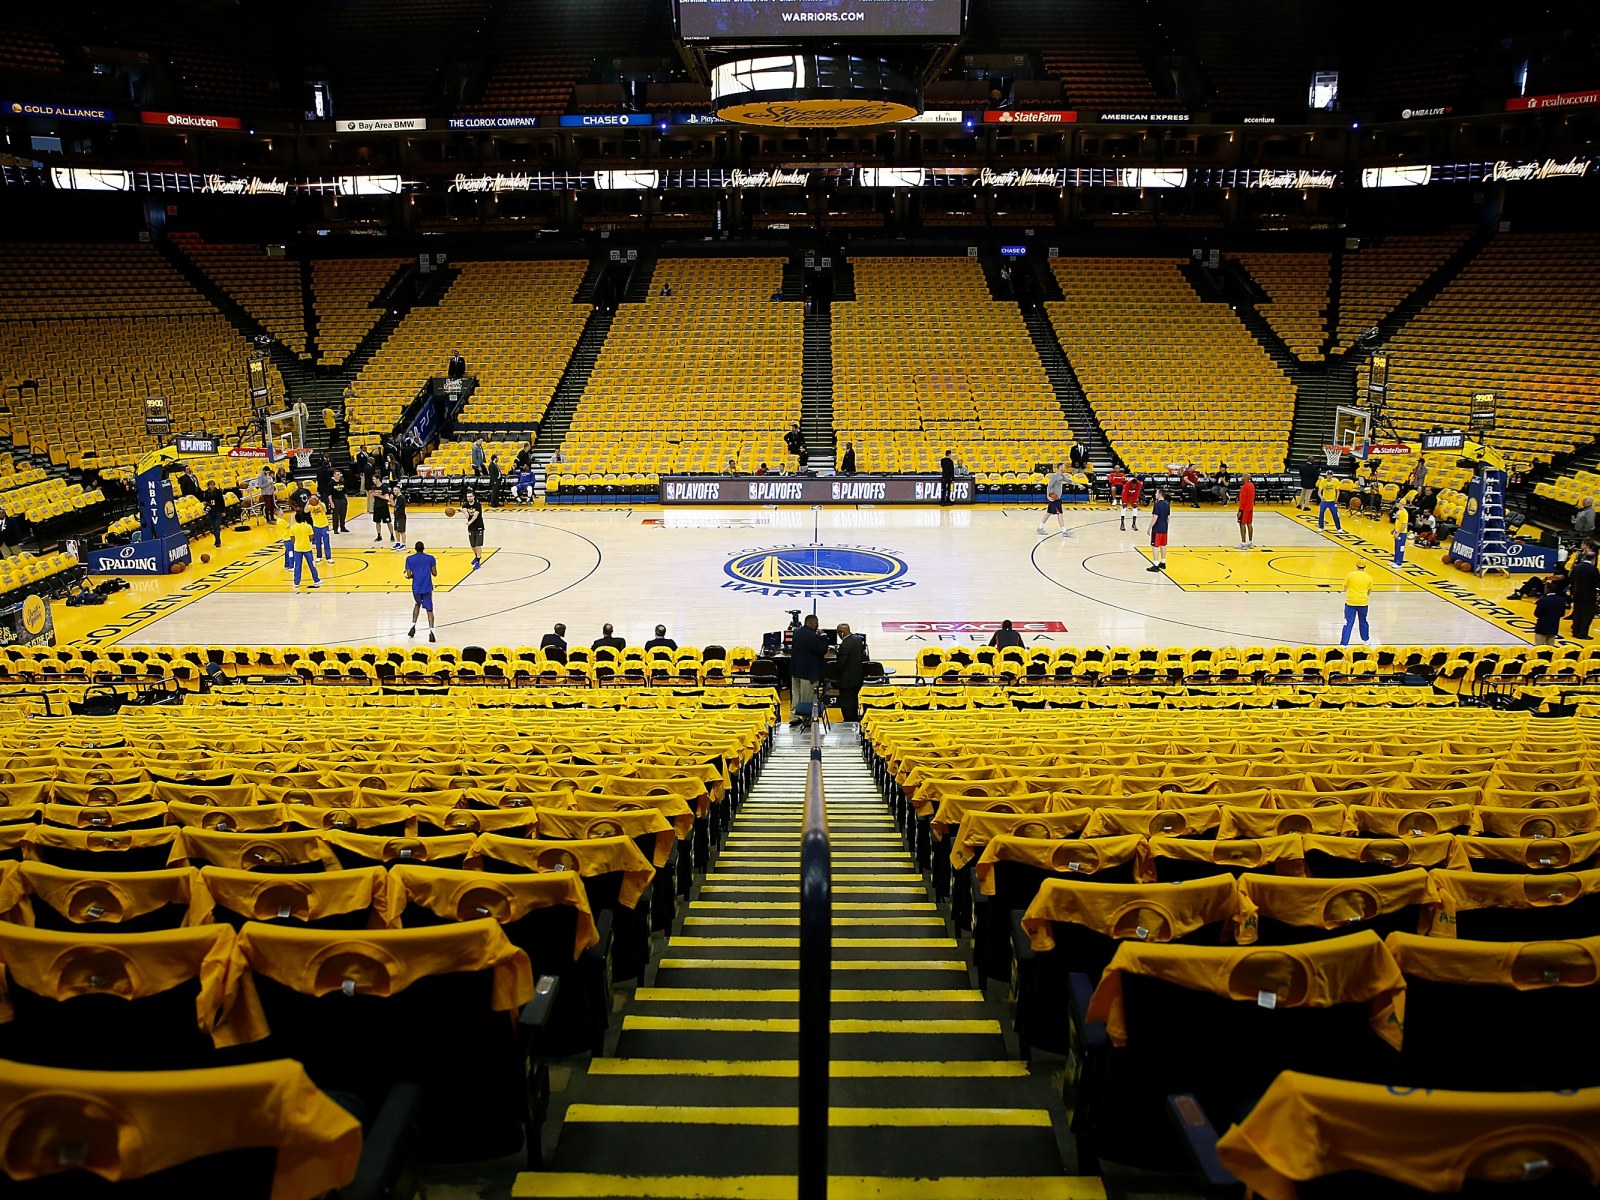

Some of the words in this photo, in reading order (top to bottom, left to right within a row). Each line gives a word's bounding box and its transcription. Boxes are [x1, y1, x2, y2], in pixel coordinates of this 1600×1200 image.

[781, 12, 865, 22] WARRIORS.COM
[1541, 94, 1598, 108] realtor.com
[24, 105, 54, 114] GOLD
[55, 108, 105, 118] ALLIANCE
[936, 114, 958, 122] thrive
[176, 115, 219, 127] Rakuten
[358, 122, 378, 131] Bay
[379, 121, 393, 129] Area
[394, 120, 415, 129] BMW
[448, 119, 464, 127] THE
[465, 118, 496, 127] CLOROX
[497, 117, 536, 126] COMPANY
[583, 116, 618, 125] CHASE
[186, 440, 212, 451] PLAYOFFS
[1433, 435, 1461, 448] PLAYOFFS
[148, 481, 158, 506] NBA
[675, 482, 720, 500] PLAYOFFS
[757, 482, 803, 500] PLAYOFFS
[841, 482, 886, 500] PLAYOFFS
[924, 482, 969, 500] PLAFFS
[151, 508, 159, 525] TV
[728, 542, 824, 557] GOLDEN
[836, 542, 905, 557] STATE
[99, 556, 158, 572] SPALDING
[181, 559, 260, 592] STATE
[719, 579, 917, 598] WARRIORS
[4, 633, 18, 641] CAP
[904, 634, 1056, 642] AREA
